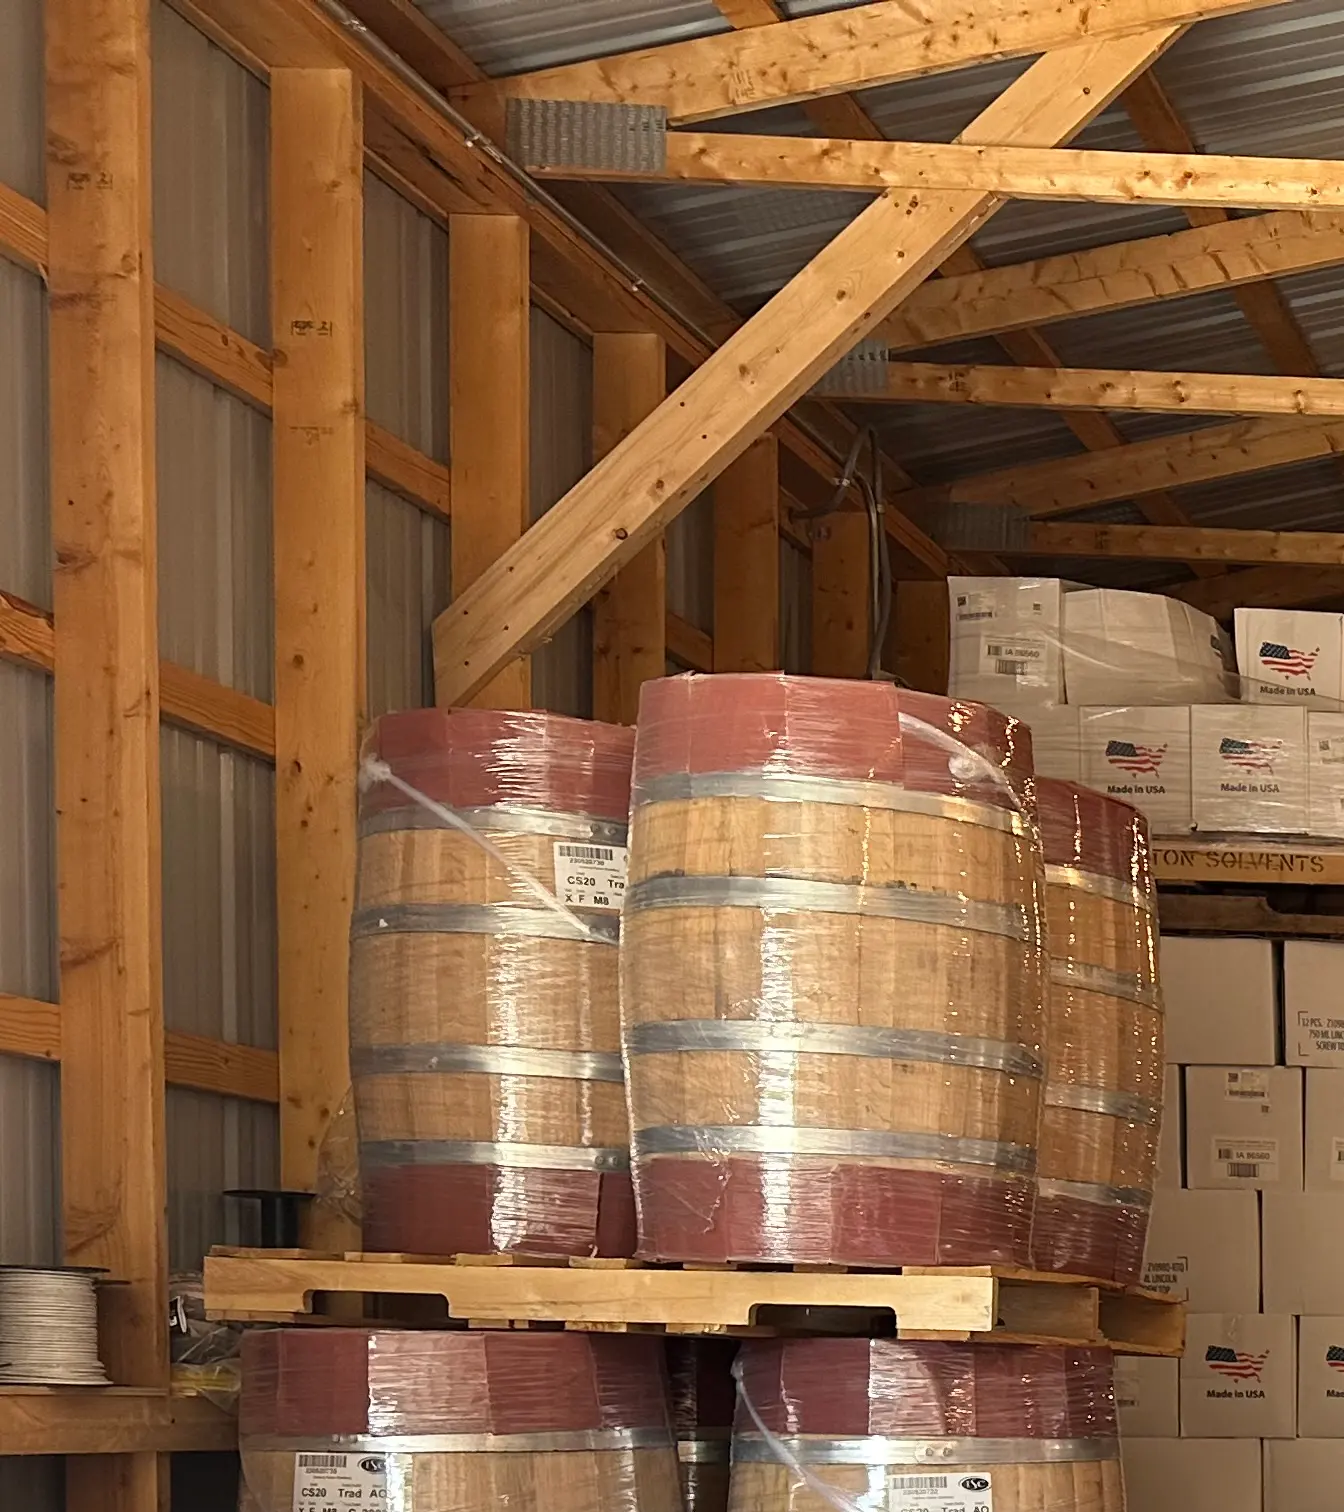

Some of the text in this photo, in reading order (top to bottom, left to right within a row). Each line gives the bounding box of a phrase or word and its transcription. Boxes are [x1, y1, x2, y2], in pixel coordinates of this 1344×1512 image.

[1259, 685, 1316, 696] Made in USA
[1107, 784, 1166, 795] Made in USA
[1220, 783, 1280, 793] Made in USA
[1205, 851, 1325, 873] SOLVENTS
[567, 876, 625, 889] CS20 Tra
[565, 894, 573, 903] X
[578, 894, 585, 903] F
[1206, 1389, 1266, 1399] Made in USA
[301, 1487, 327, 1498] CS20
[338, 1488, 362, 1498] Trad
